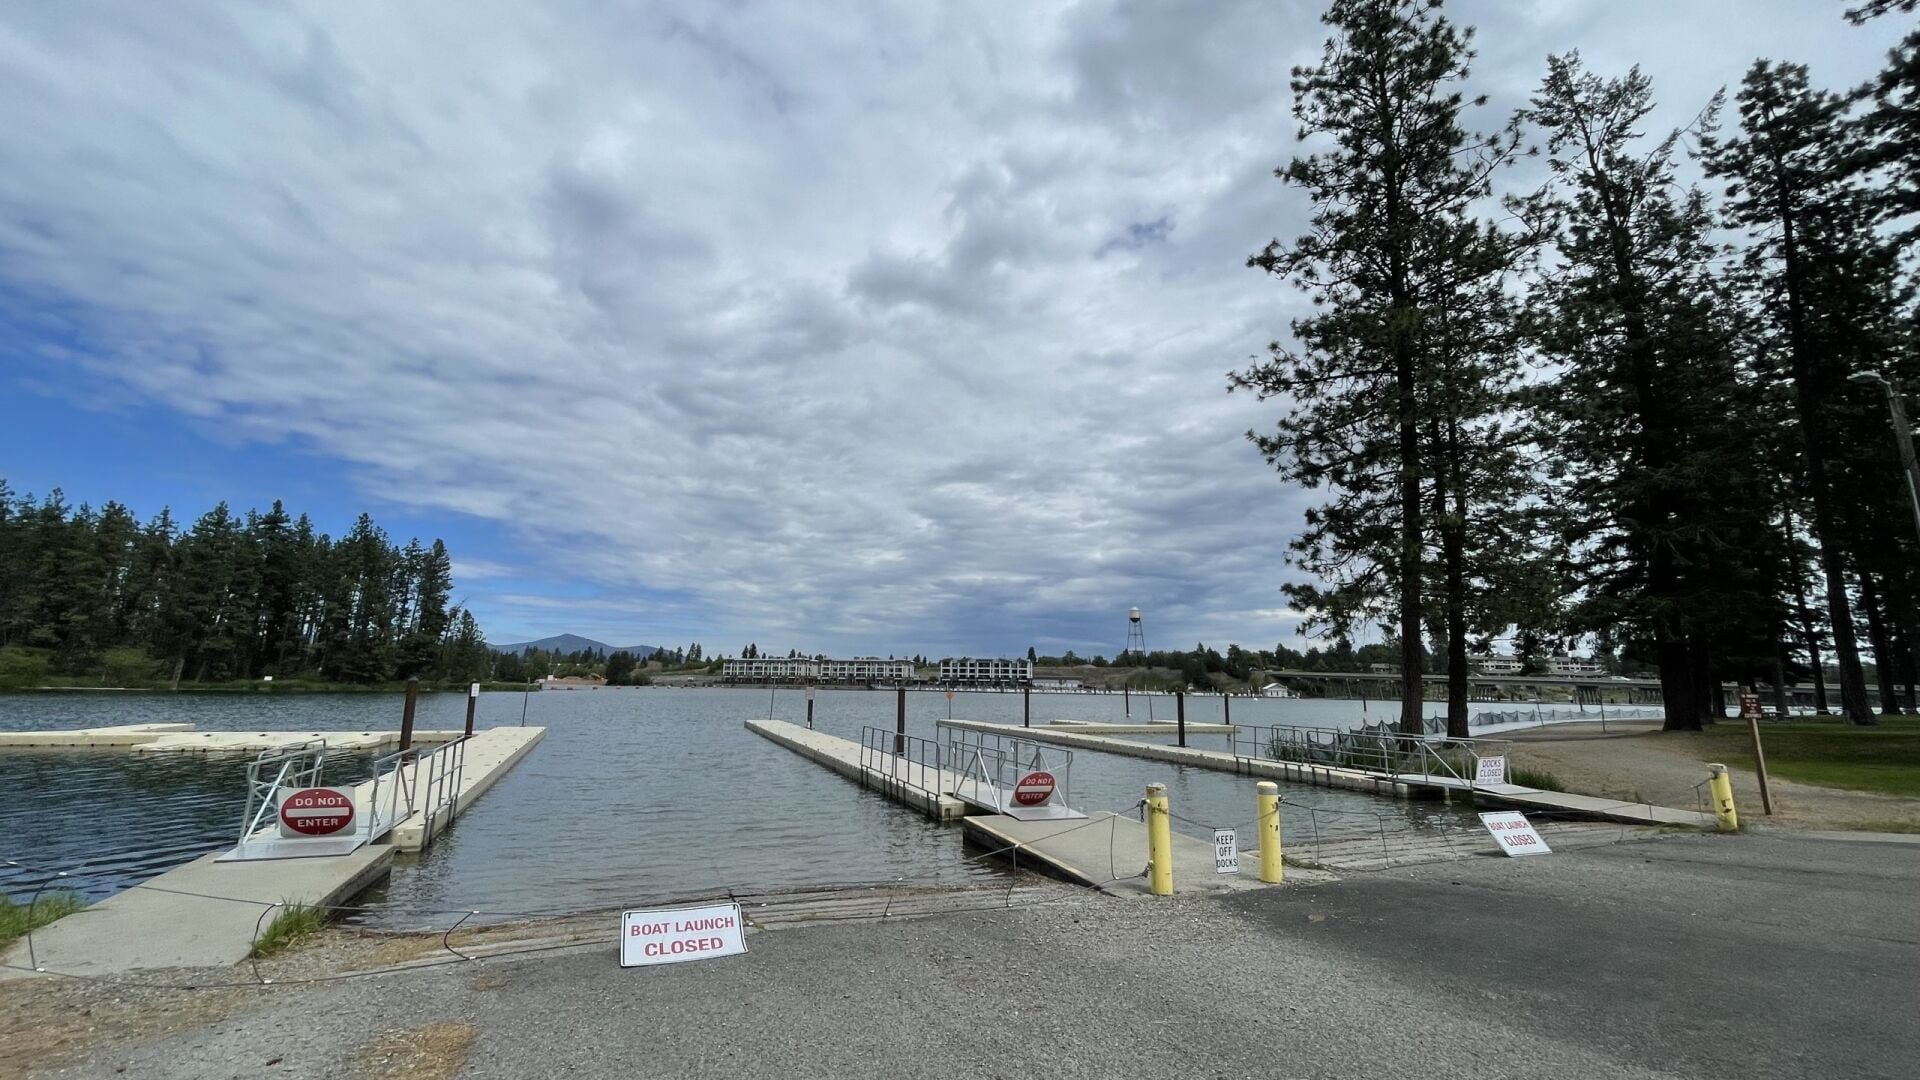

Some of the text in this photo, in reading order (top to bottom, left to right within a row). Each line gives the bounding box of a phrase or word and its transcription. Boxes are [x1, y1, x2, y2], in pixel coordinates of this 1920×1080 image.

[1482, 760, 1501, 768] DOCKS
[1480, 769, 1501, 777] CLOSED
[296, 797, 344, 807] DO NOT
[297, 818, 339, 828] ENTER
[1216, 834, 1234, 845] KEEP
[1504, 834, 1536, 846] CLOSED
[1219, 846, 1232, 857] OFF
[1216, 858, 1238, 868] DOCKS
[630, 916, 735, 937] BOAT LAUNCH
[645, 937, 724, 956] CLOSED
